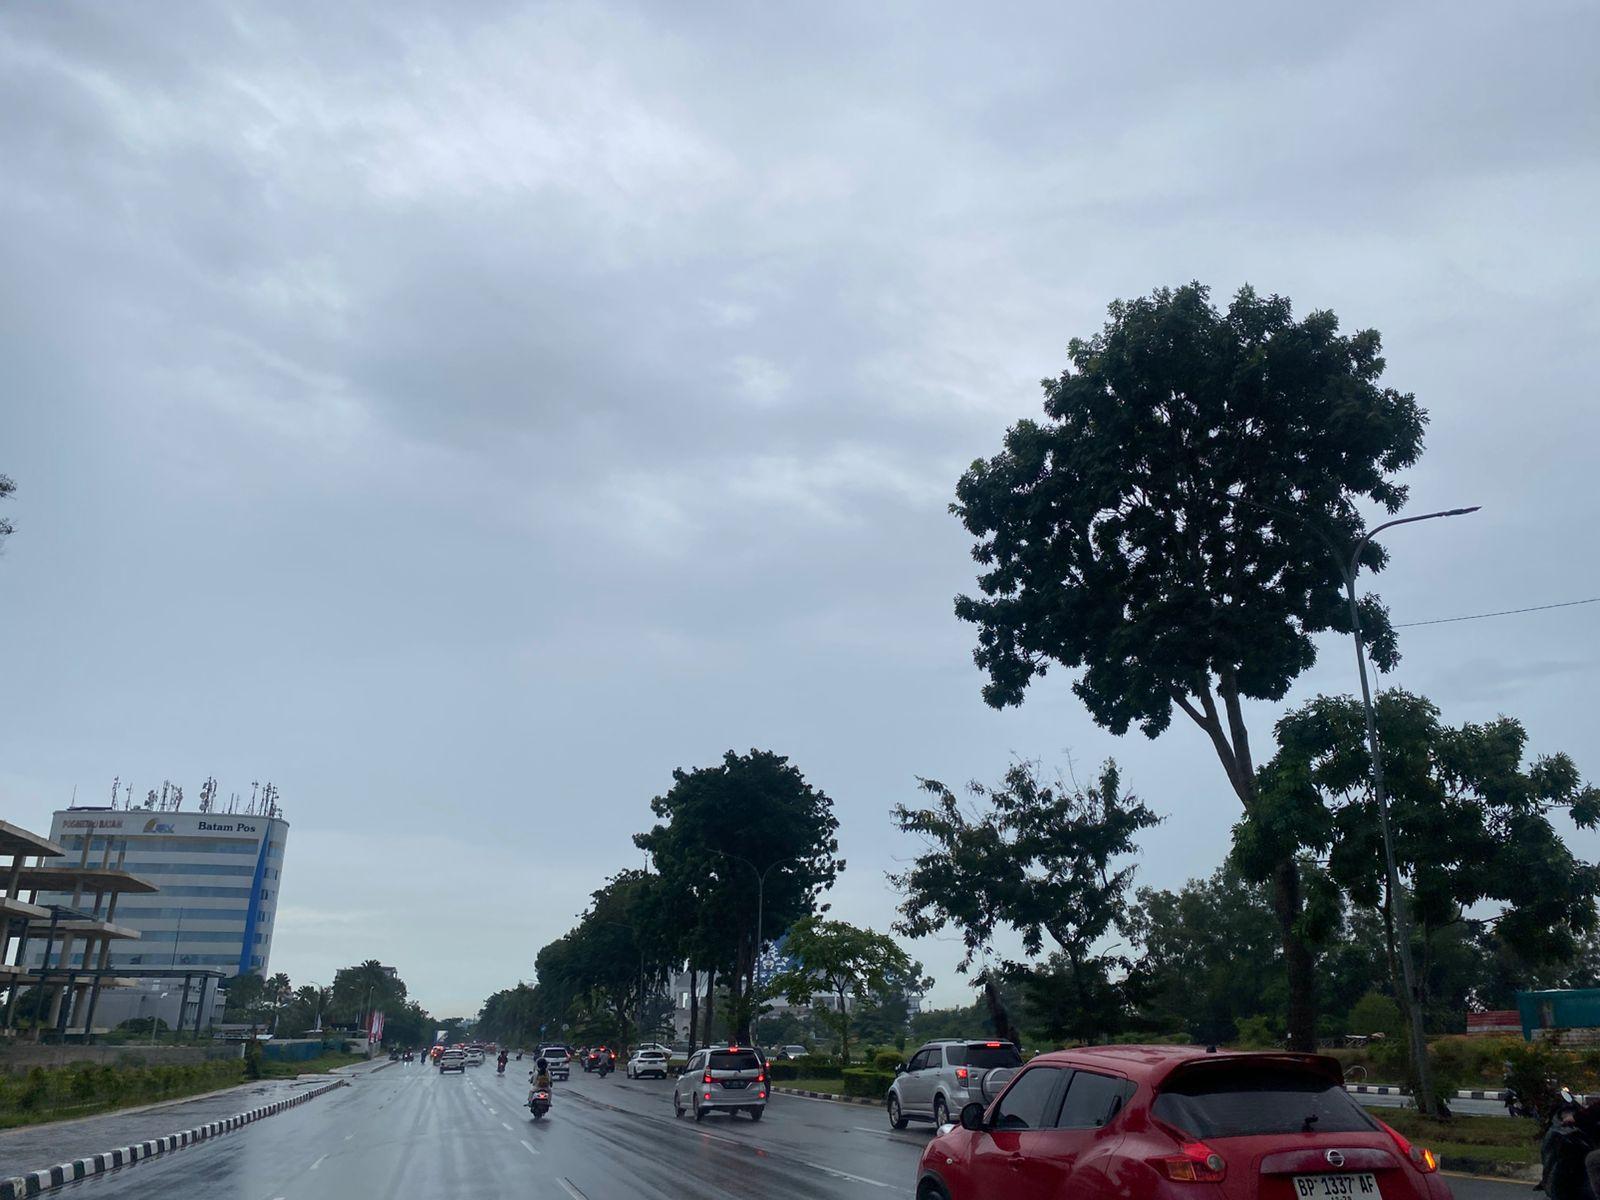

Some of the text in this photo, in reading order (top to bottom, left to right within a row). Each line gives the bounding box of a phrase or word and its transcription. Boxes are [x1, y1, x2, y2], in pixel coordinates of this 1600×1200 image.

[198, 821, 256, 833] Batam Pos
[1297, 1175, 1374, 1197] BP 1337 AF
